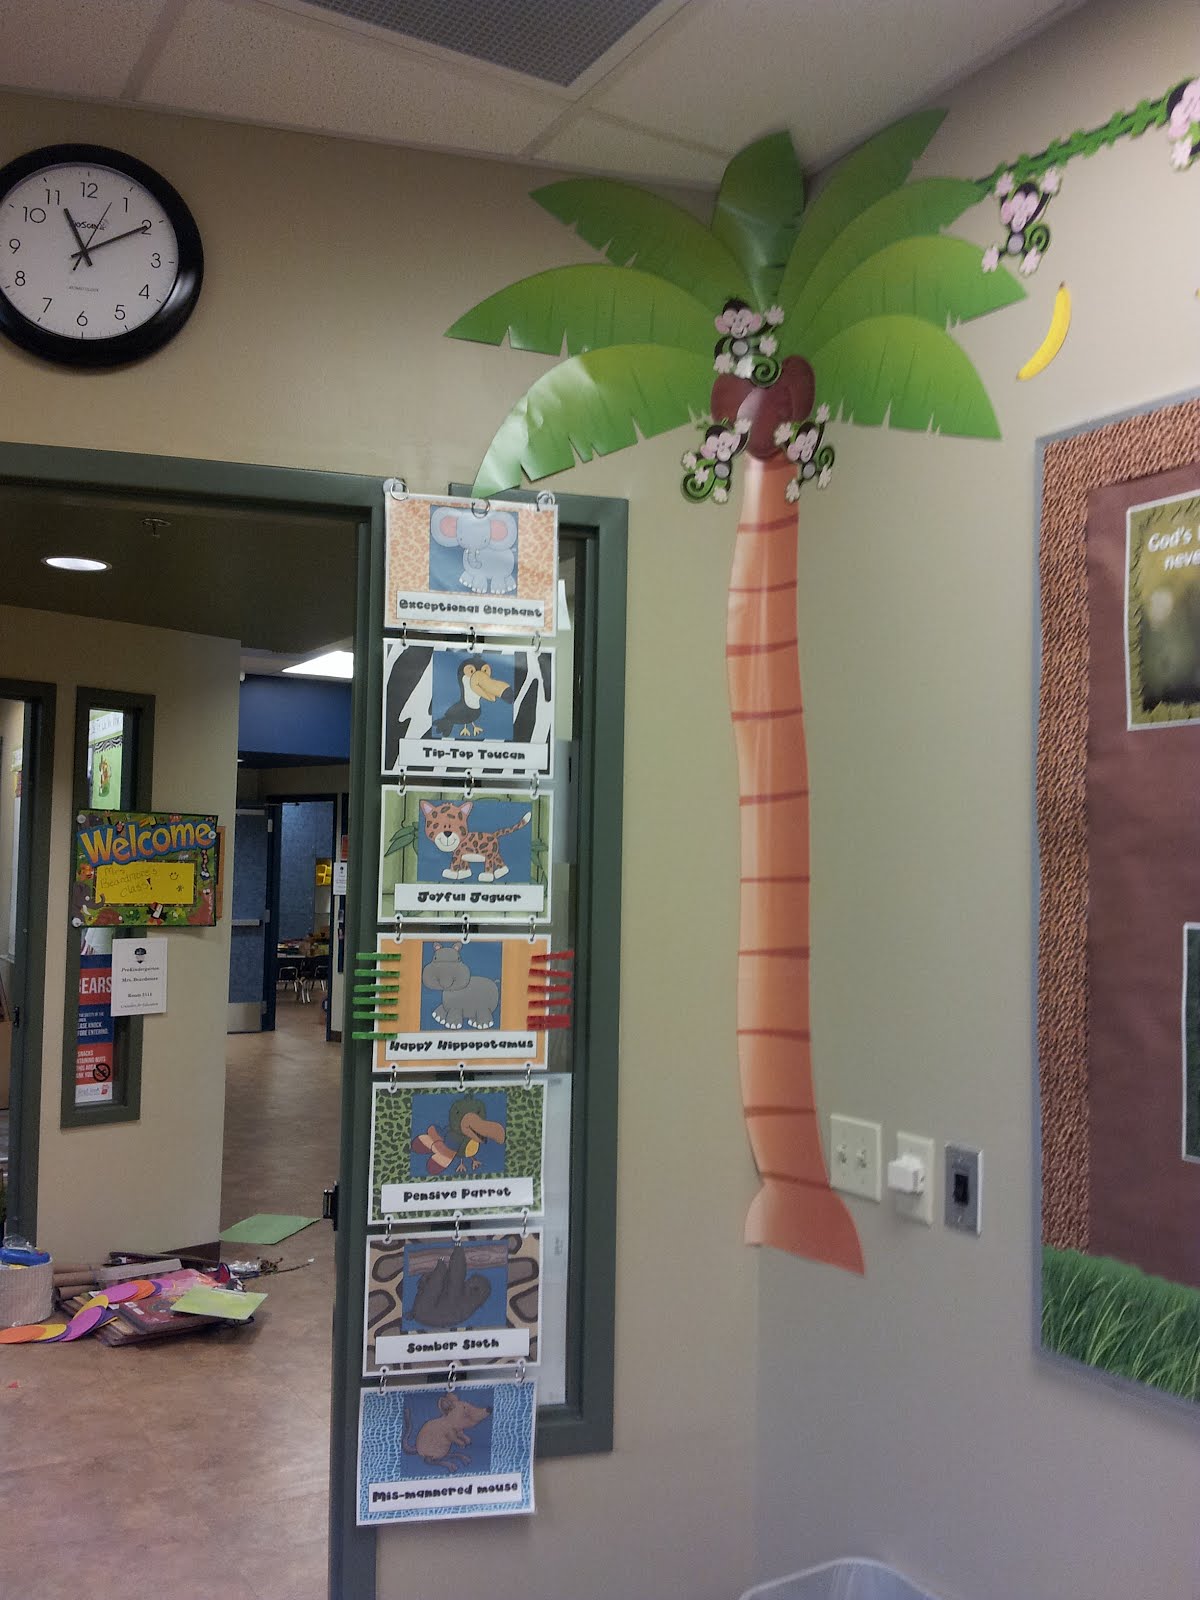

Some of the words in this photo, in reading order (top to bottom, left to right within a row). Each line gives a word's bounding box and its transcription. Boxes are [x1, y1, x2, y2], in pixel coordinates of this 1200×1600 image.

[45, 188, 60, 206] 11
[80, 181, 98, 199] 12
[122, 197, 128, 213] 1
[22, 206, 47, 223] 10
[140, 219, 152, 236] 2
[9, 238, 21, 254] 9
[150, 252, 161, 269] 3
[14, 270, 26, 287] 8
[138, 283, 150, 300] 4
[42, 297, 53, 313] 7
[114, 304, 126, 320] 5
[76, 310, 88, 327] 6
[1147, 526, 1193, 553] God's
[399, 598, 480, 614] Exceptional
[483, 604, 543, 618] Elephant
[422, 747, 474, 760] Tip-Top
[478, 749, 526, 760] Toucan
[78, 820, 215, 865] Welcome
[417, 891, 466, 904] Joyful
[469, 892, 522, 904] Jaguar
[389, 1040, 433, 1053] Happy
[437, 1039, 534, 1051] Hippopotamus
[461, 1187, 511, 1200] Parrot
[407, 1341, 458, 1354] Somber
[462, 1338, 500, 1351] Sloth
[372, 1484, 473, 1503] Mis-mannered
[477, 1482, 518, 1494] mouse
